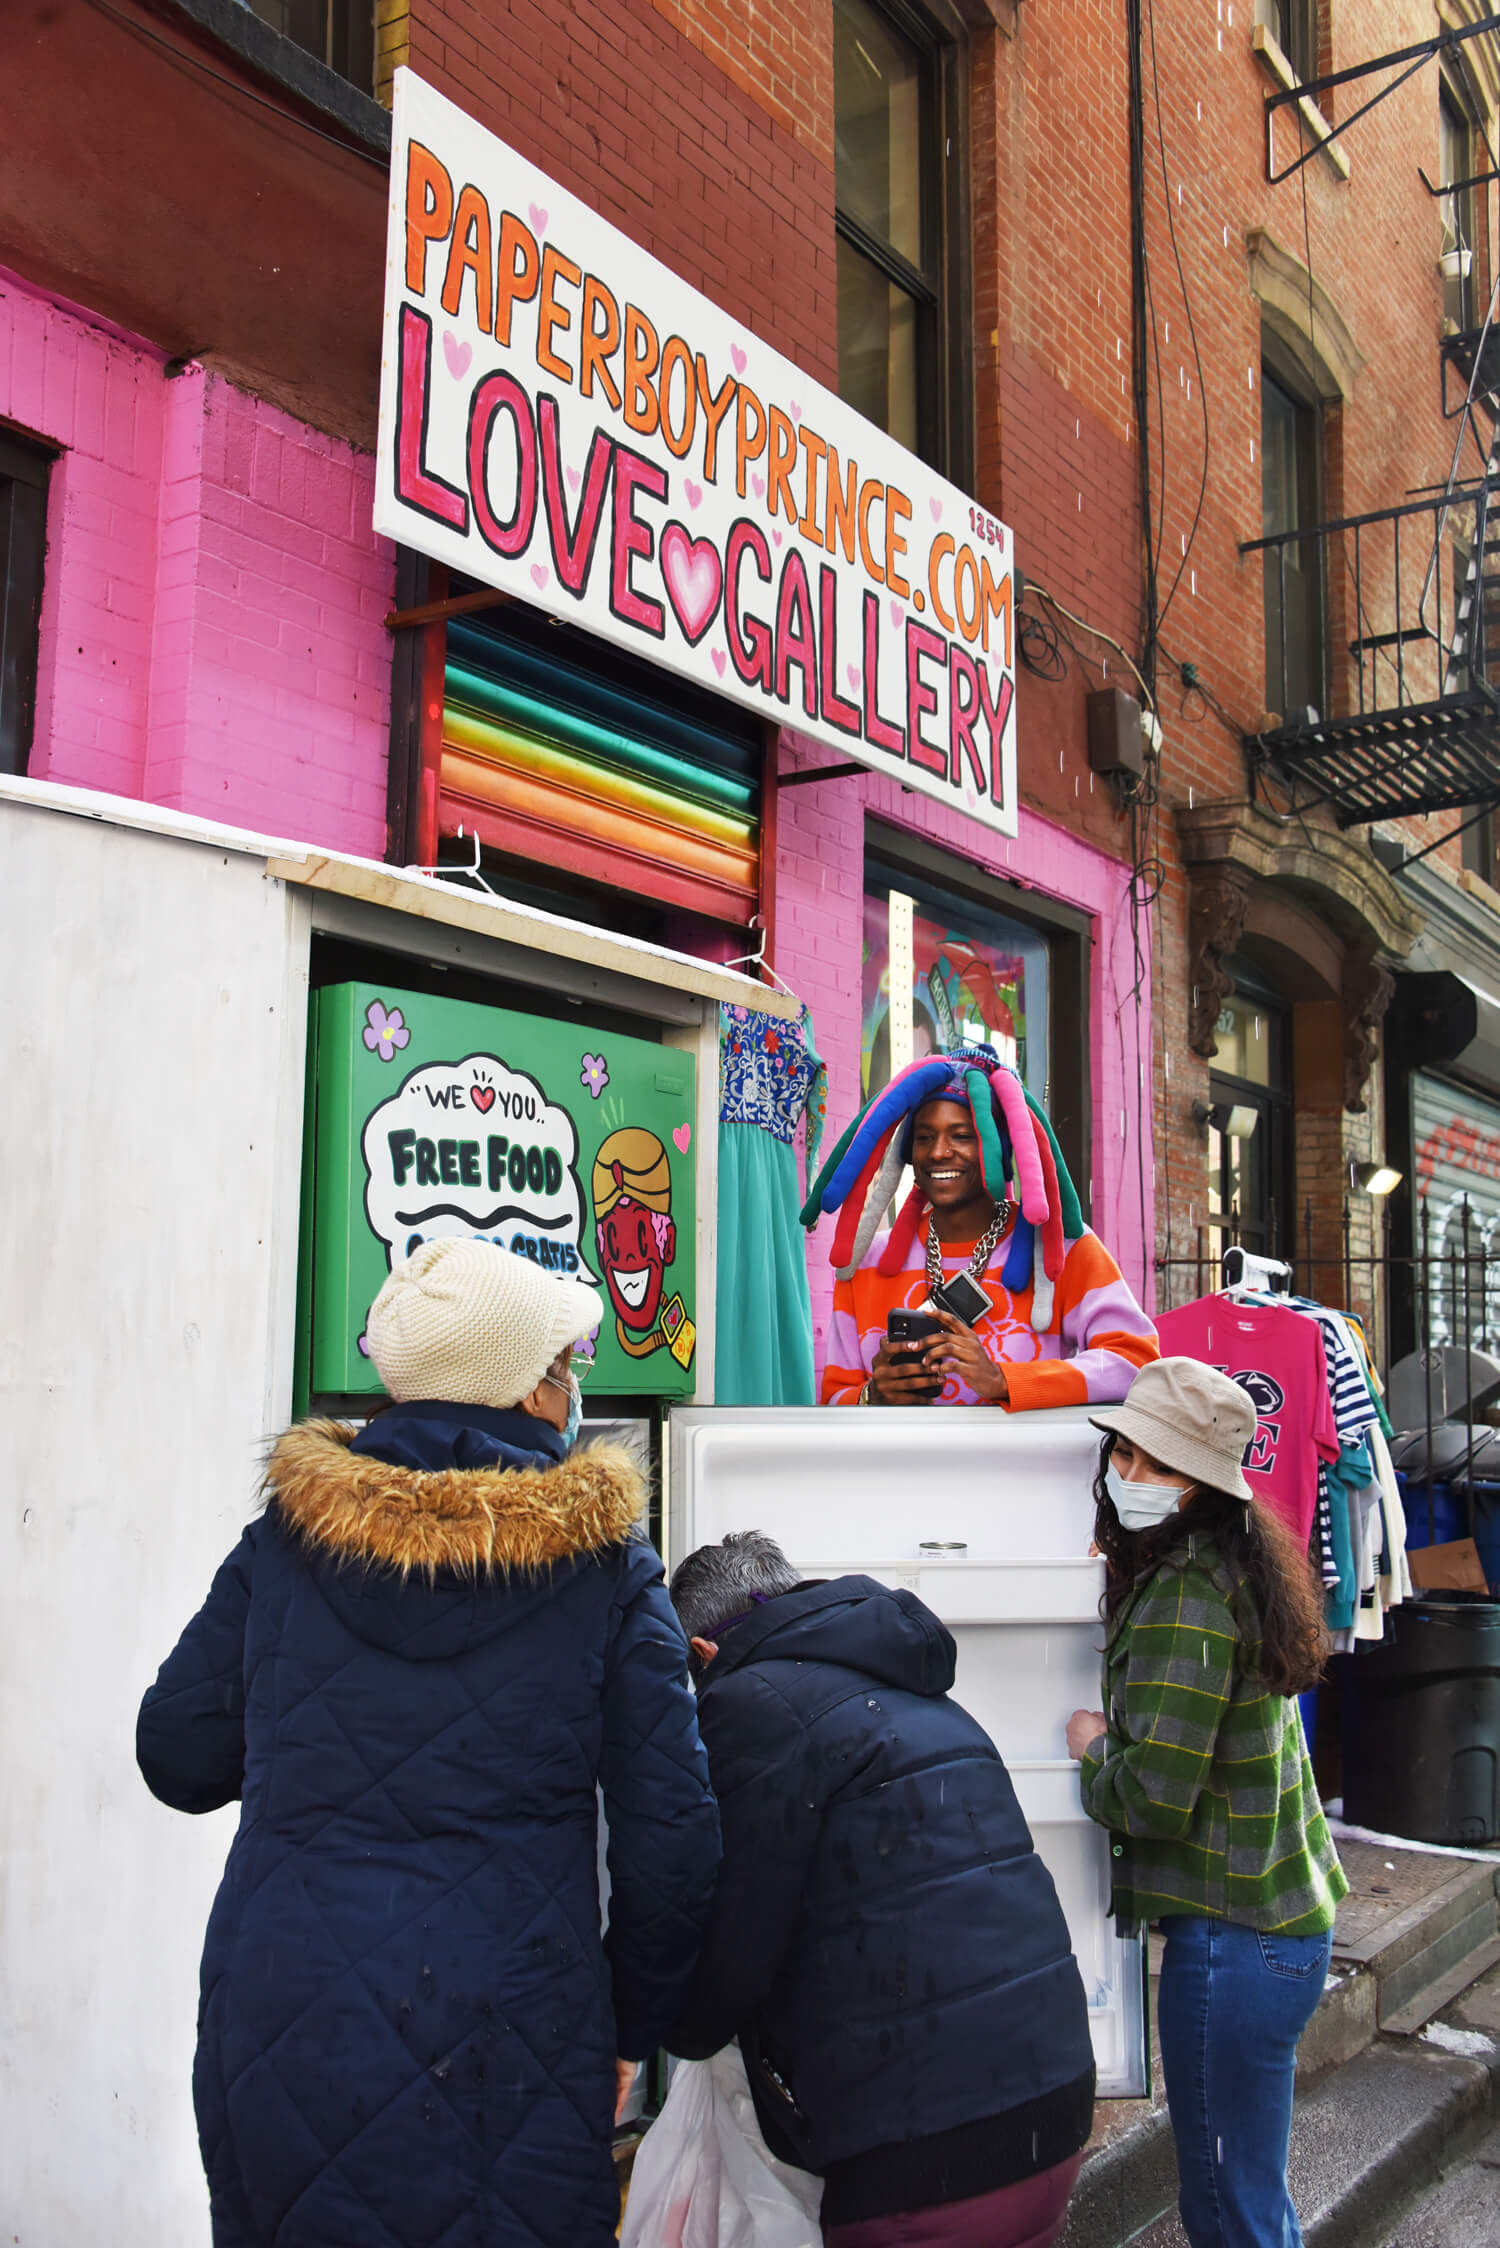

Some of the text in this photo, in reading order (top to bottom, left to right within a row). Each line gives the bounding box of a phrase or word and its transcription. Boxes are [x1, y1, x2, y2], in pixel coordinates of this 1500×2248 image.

[405, 138, 1012, 668] PAPERBOYPRINCE.COM
[394, 302, 1013, 810] LOVE GALLERY
[968, 506, 1004, 554] 1254
[387, 1128, 563, 1196] FREE FOOD
[510, 1232, 579, 1273] GRATIS
